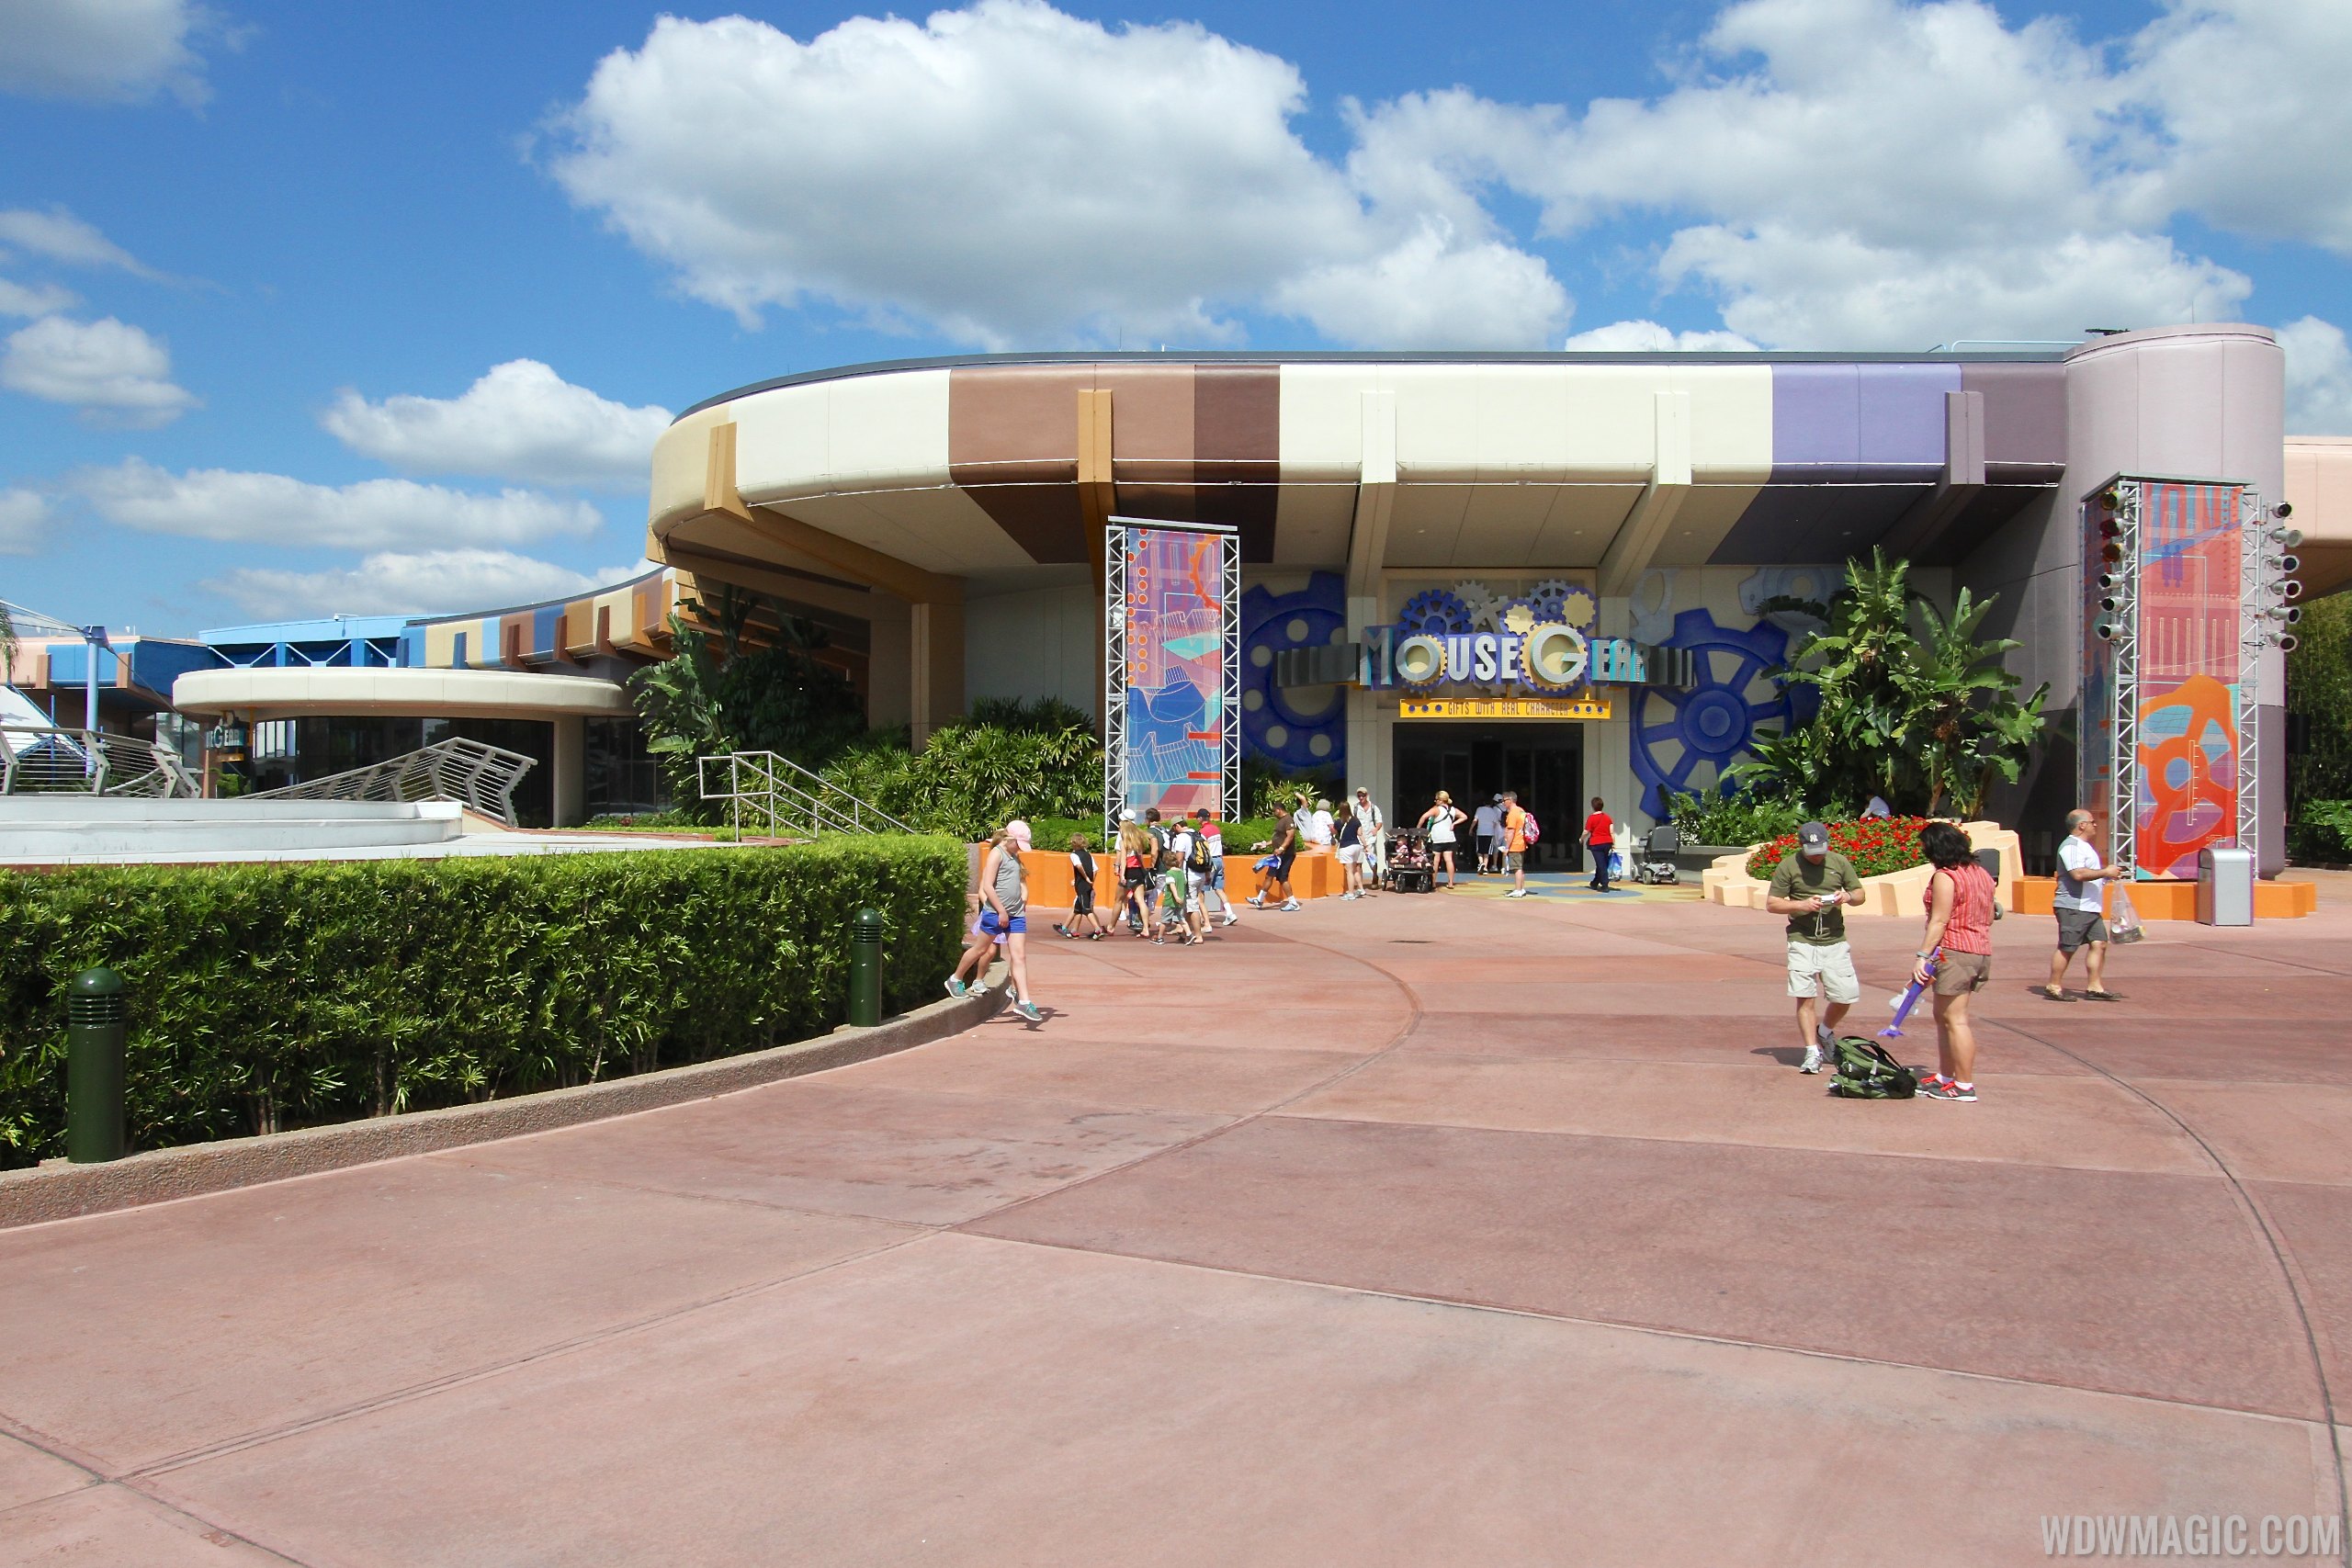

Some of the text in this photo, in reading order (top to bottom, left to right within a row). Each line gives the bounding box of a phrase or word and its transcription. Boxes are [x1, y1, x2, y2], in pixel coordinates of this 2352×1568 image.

[1359, 625, 1650, 686] MOUSE GEAR
[1448, 702, 1569, 716] GIFTS WITH REAL CHARACTER
